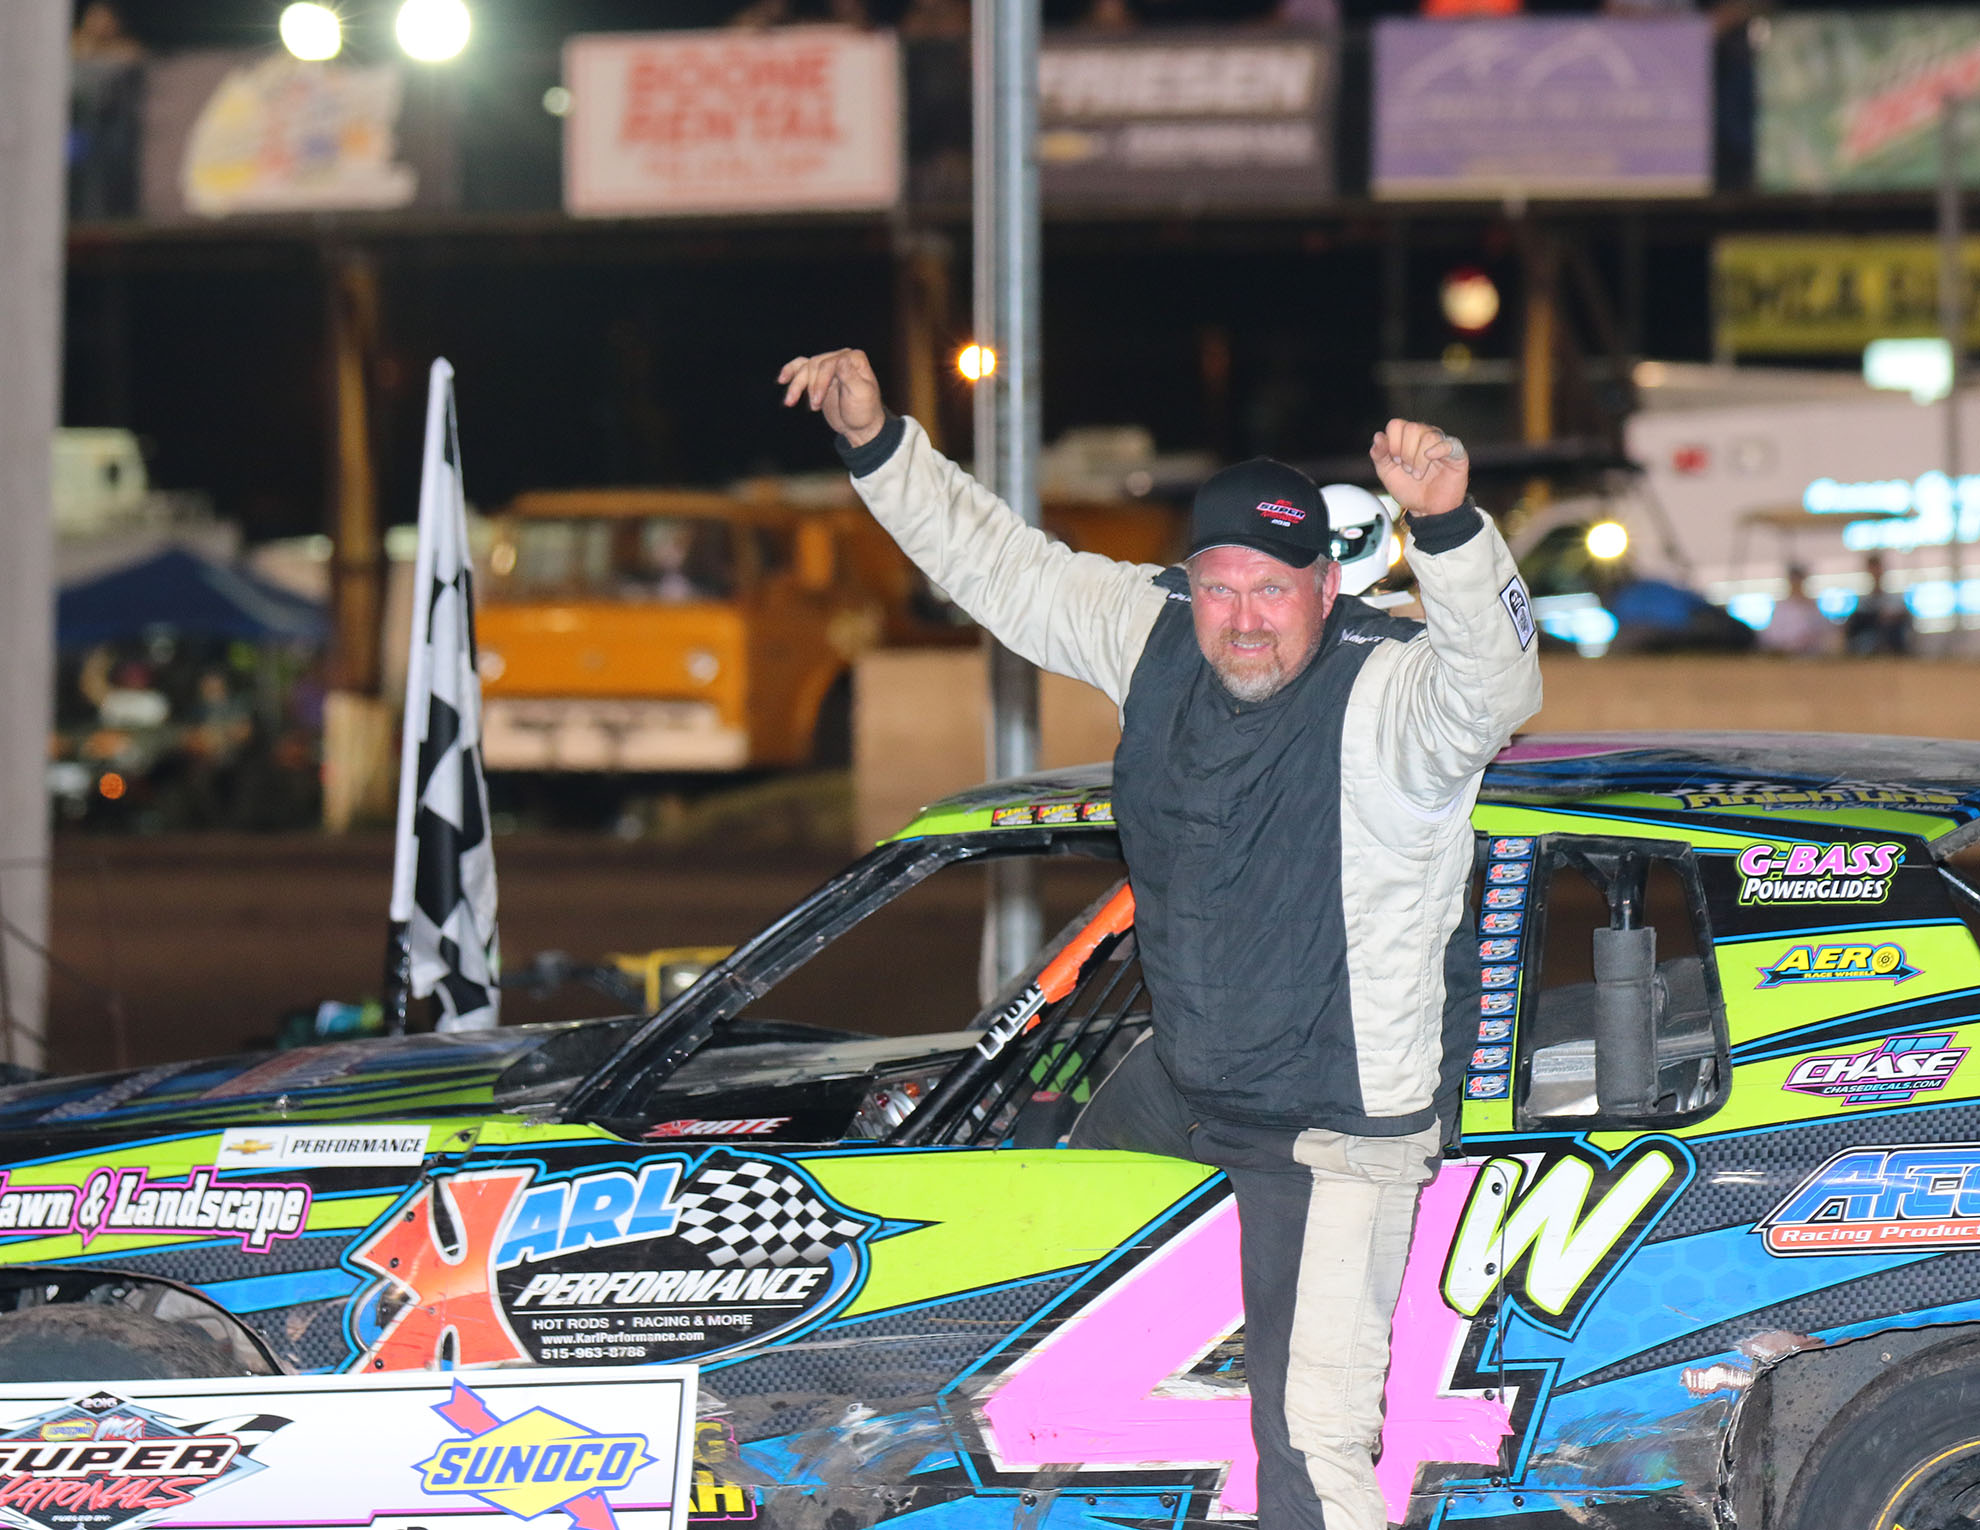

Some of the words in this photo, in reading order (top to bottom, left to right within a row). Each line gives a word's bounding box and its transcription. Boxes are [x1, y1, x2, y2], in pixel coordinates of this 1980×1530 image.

[1740, 845, 1899, 876] G-BASS
[1743, 878, 1886, 899] POWERGLIDES
[1775, 946, 1900, 973] AERO
[1789, 1051, 1963, 1085] CHASE
[1823, 1079, 1942, 1094] CHASEDECALS.COM
[291, 1138, 424, 1153] PERFORMANCE
[0, 1191, 75, 1228] awn
[79, 1173, 109, 1228] &
[108, 1172, 306, 1246] Landscape
[1445, 1150, 1675, 1316] W
[1780, 1228, 1872, 1242] Racing
[511, 1267, 829, 1306] PERFORMANCE
[532, 1319, 564, 1330] HOT
[566, 1318, 610, 1330] RODS
[632, 1316, 690, 1329] RACING
[693, 1315, 705, 1327] &
[707, 1314, 753, 1326] MORE
[541, 1331, 705, 1345] www.KarlPerformance.com
[430, 1442, 637, 1485] SUNOCO
